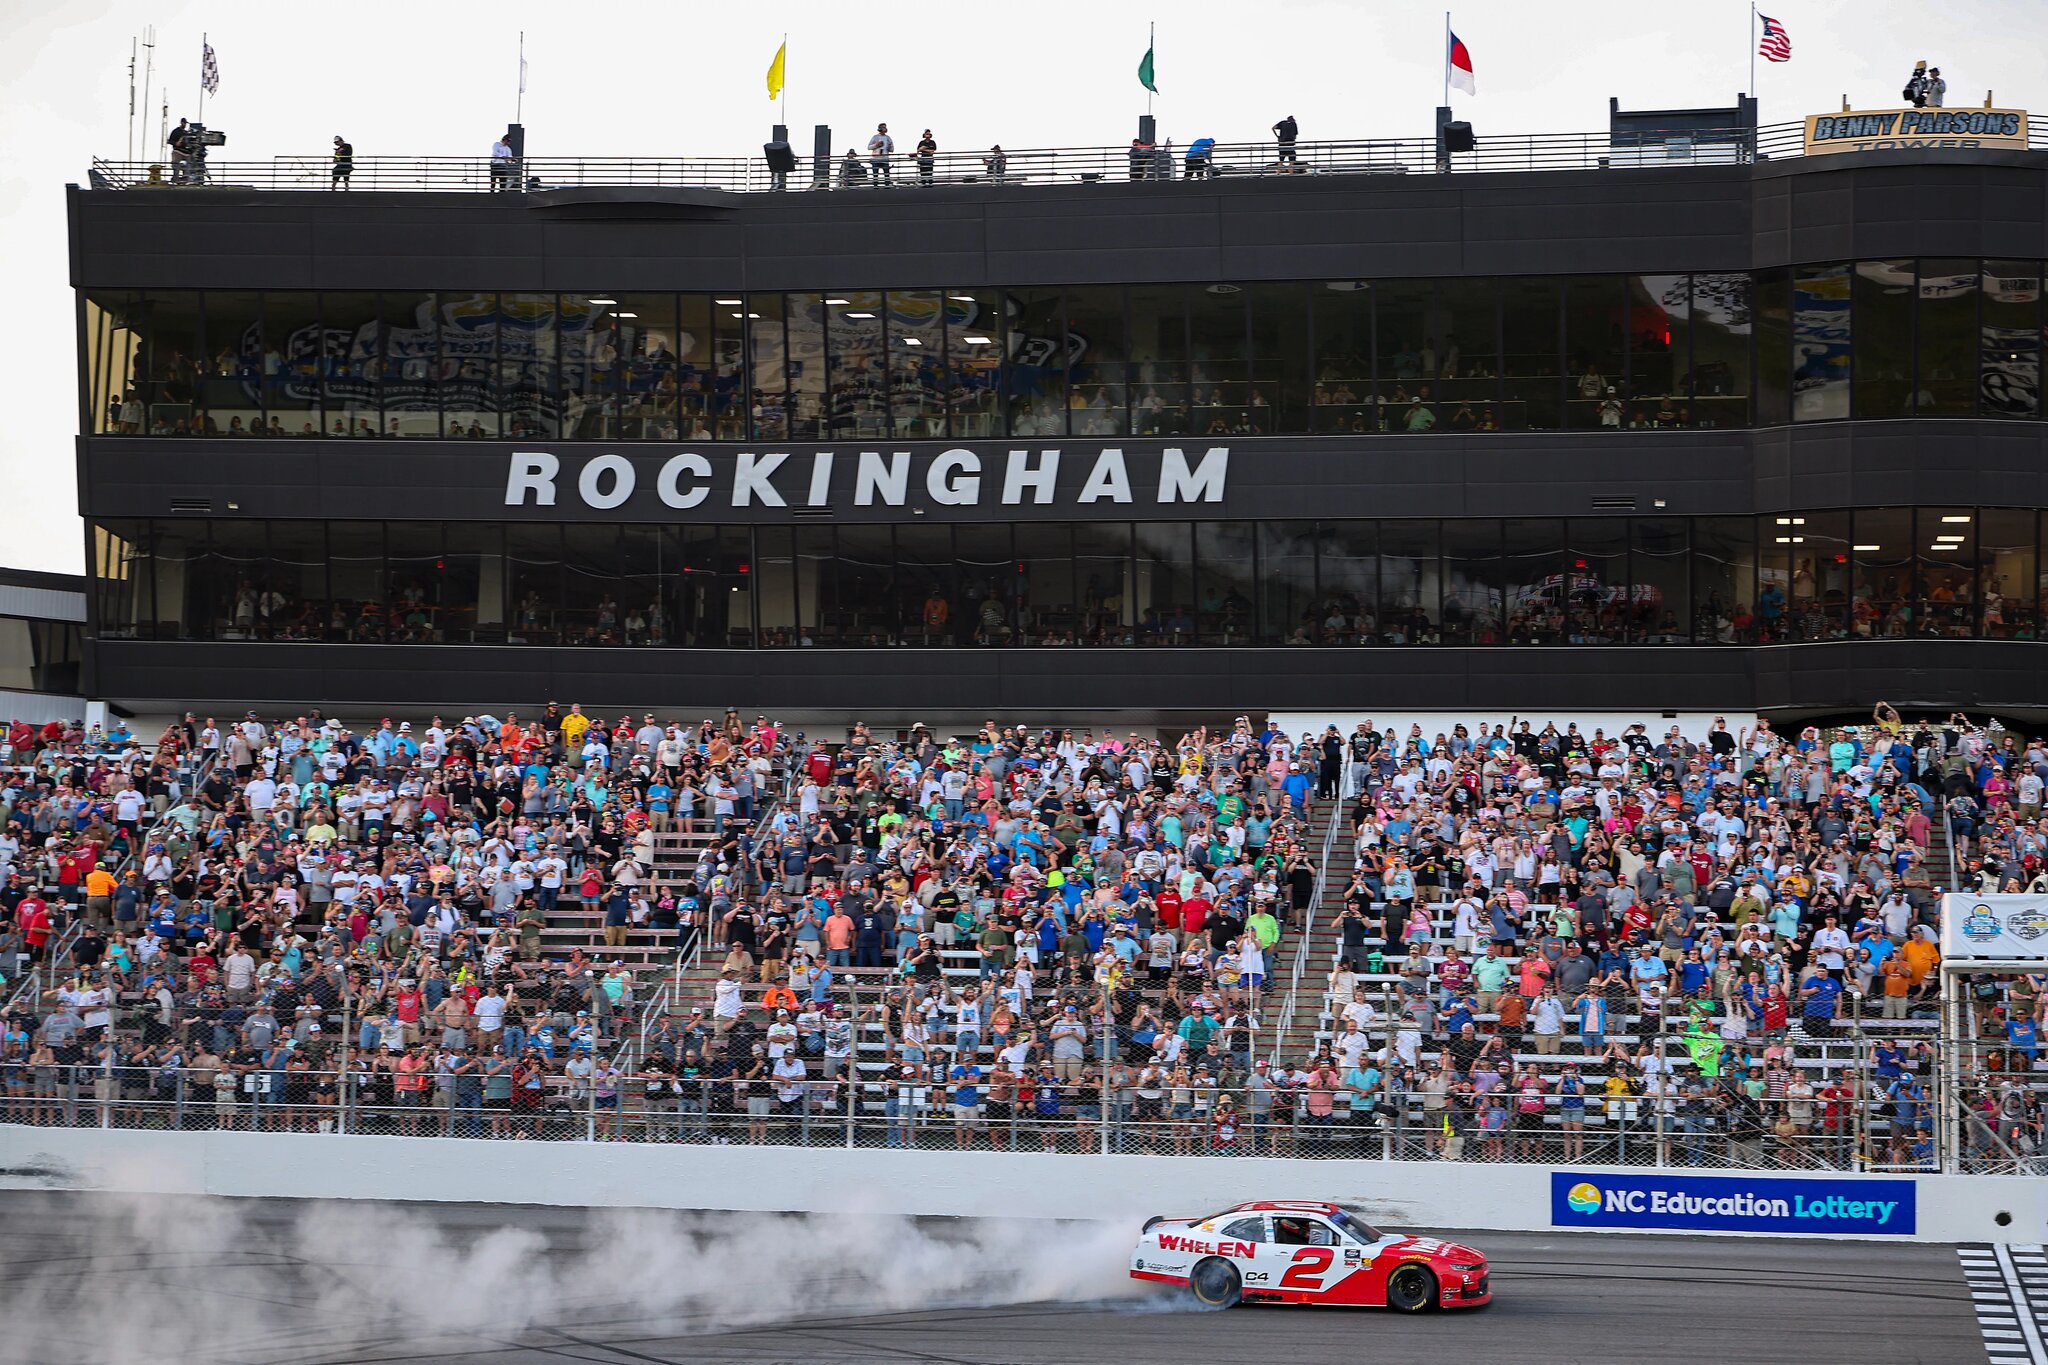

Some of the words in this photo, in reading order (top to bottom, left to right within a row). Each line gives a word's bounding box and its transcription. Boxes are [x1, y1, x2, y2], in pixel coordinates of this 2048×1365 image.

[1813, 114, 1901, 142] BENNY
[1900, 111, 2020, 136] PARSONS
[504, 448, 1229, 509] ROCKINGHAM
[1605, 1190, 1646, 1213] NC
[1651, 1191, 1790, 1217] Education
[1794, 1195, 1897, 1225] Lottery
[1158, 1233, 1256, 1259] WHELEN
[1245, 1272, 1269, 1281] C4
[1279, 1247, 1334, 1289] 2
